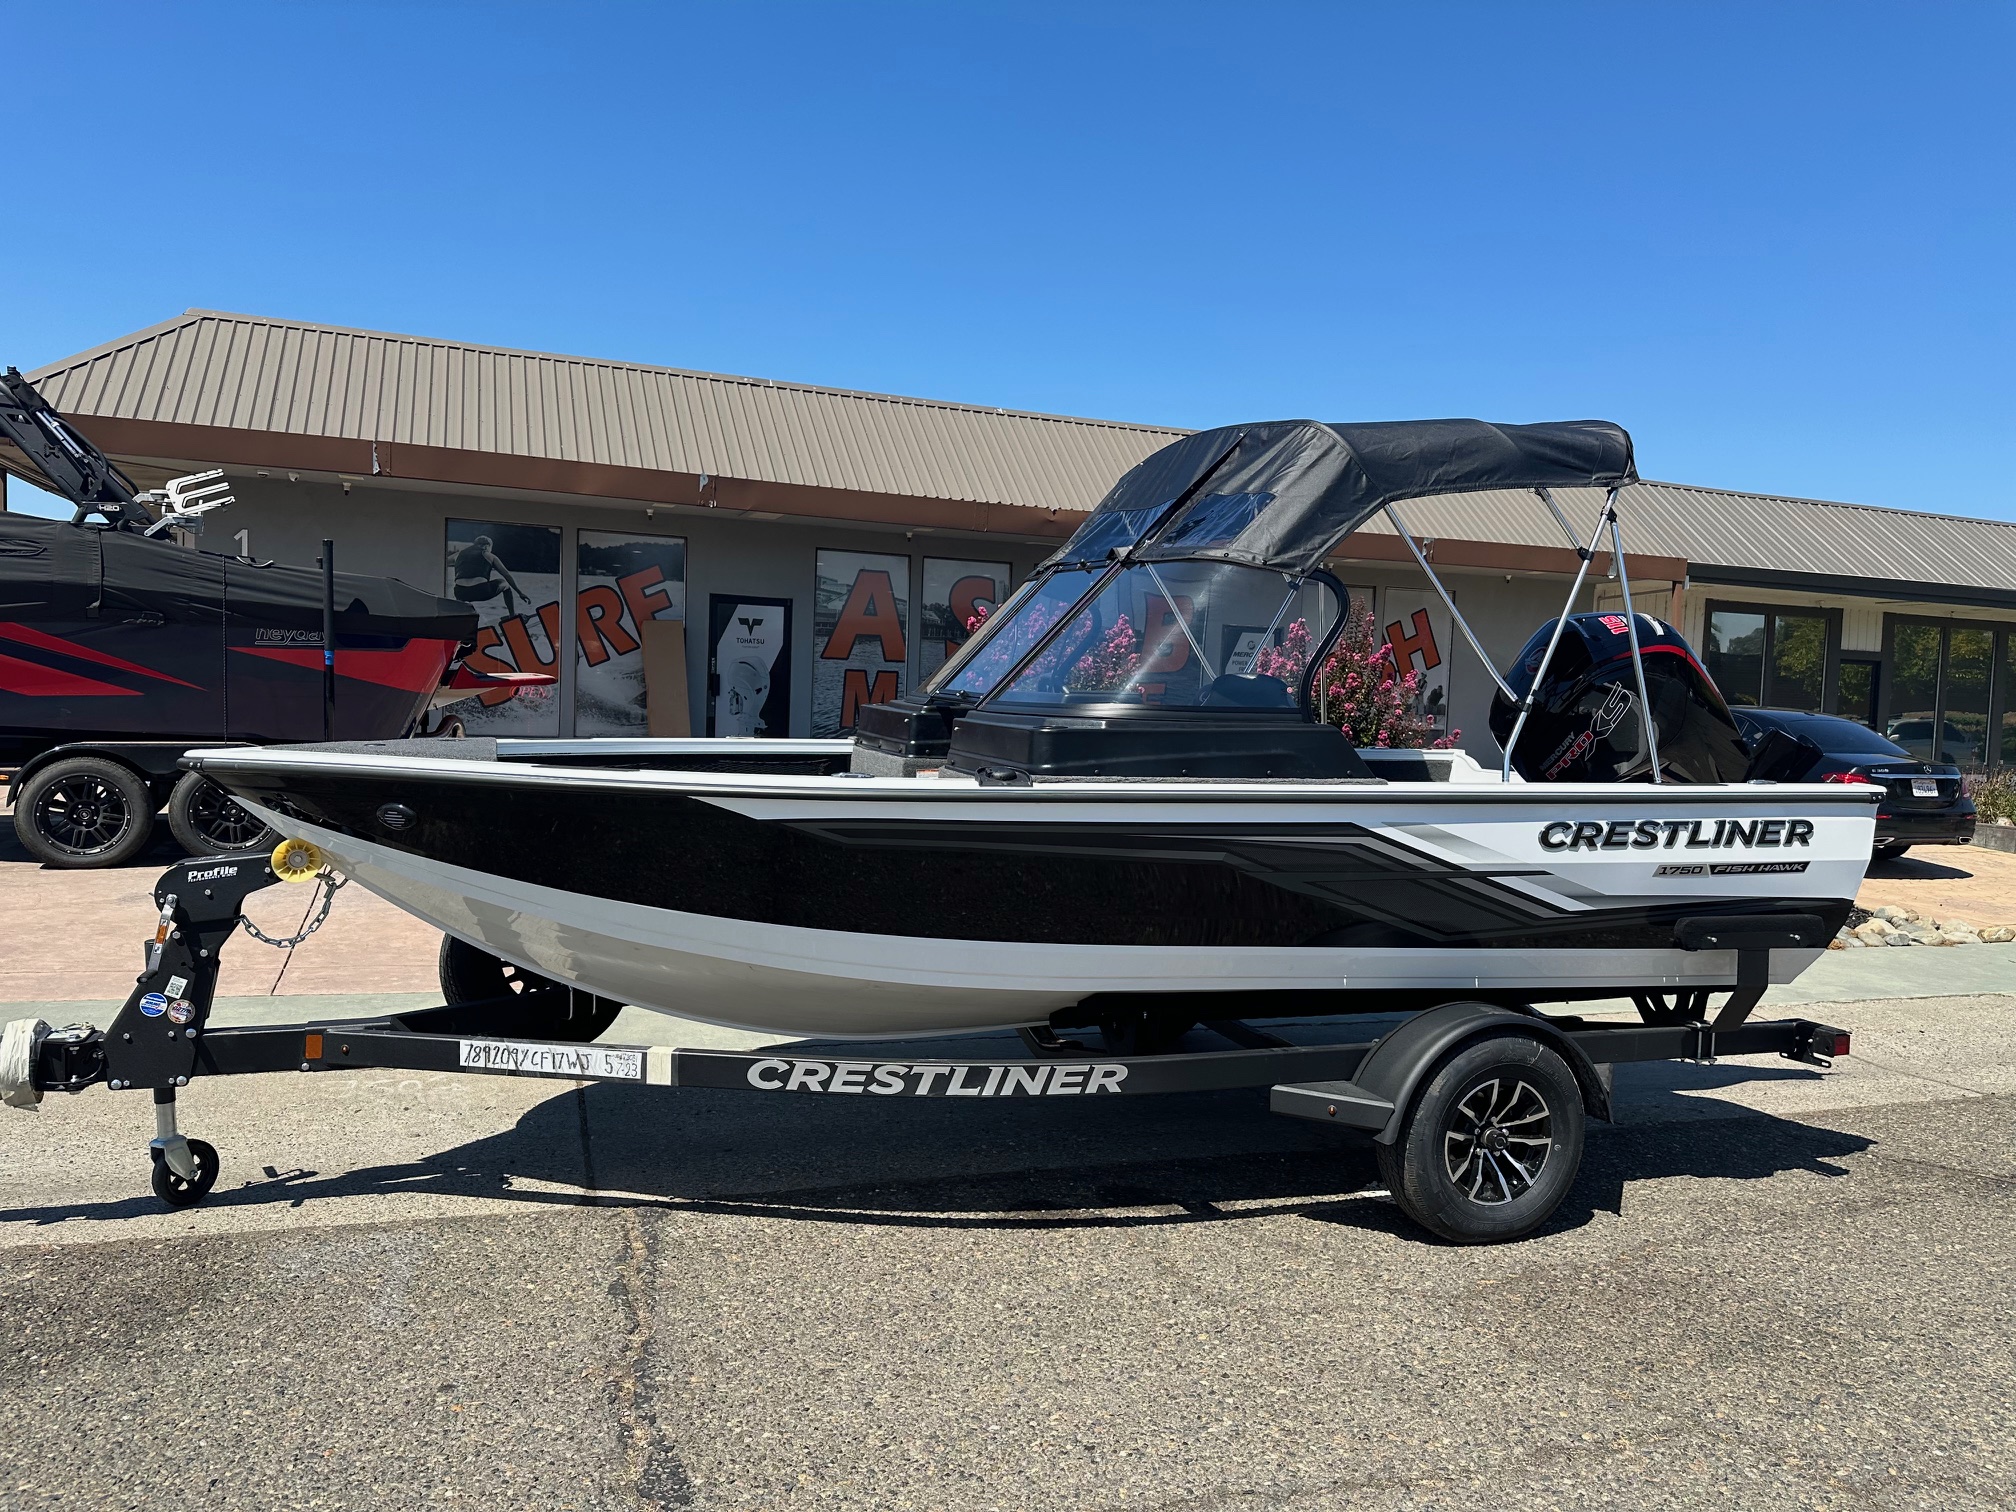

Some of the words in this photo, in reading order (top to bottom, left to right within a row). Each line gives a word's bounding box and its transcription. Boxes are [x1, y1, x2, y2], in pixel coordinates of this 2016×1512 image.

[461, 564, 673, 708] SURF
[736, 637, 765, 645] TOHATSU
[511, 685, 547, 698] OPEN
[1540, 731, 1577, 771] MERCURY
[1538, 819, 1814, 852] CRESTLINER
[188, 866, 238, 880] Profile
[1658, 864, 1703, 875] 1750
[1713, 864, 1752, 874] FISH
[1757, 862, 1805, 873] HAWK
[746, 1059, 1129, 1097] CRESTLINER
